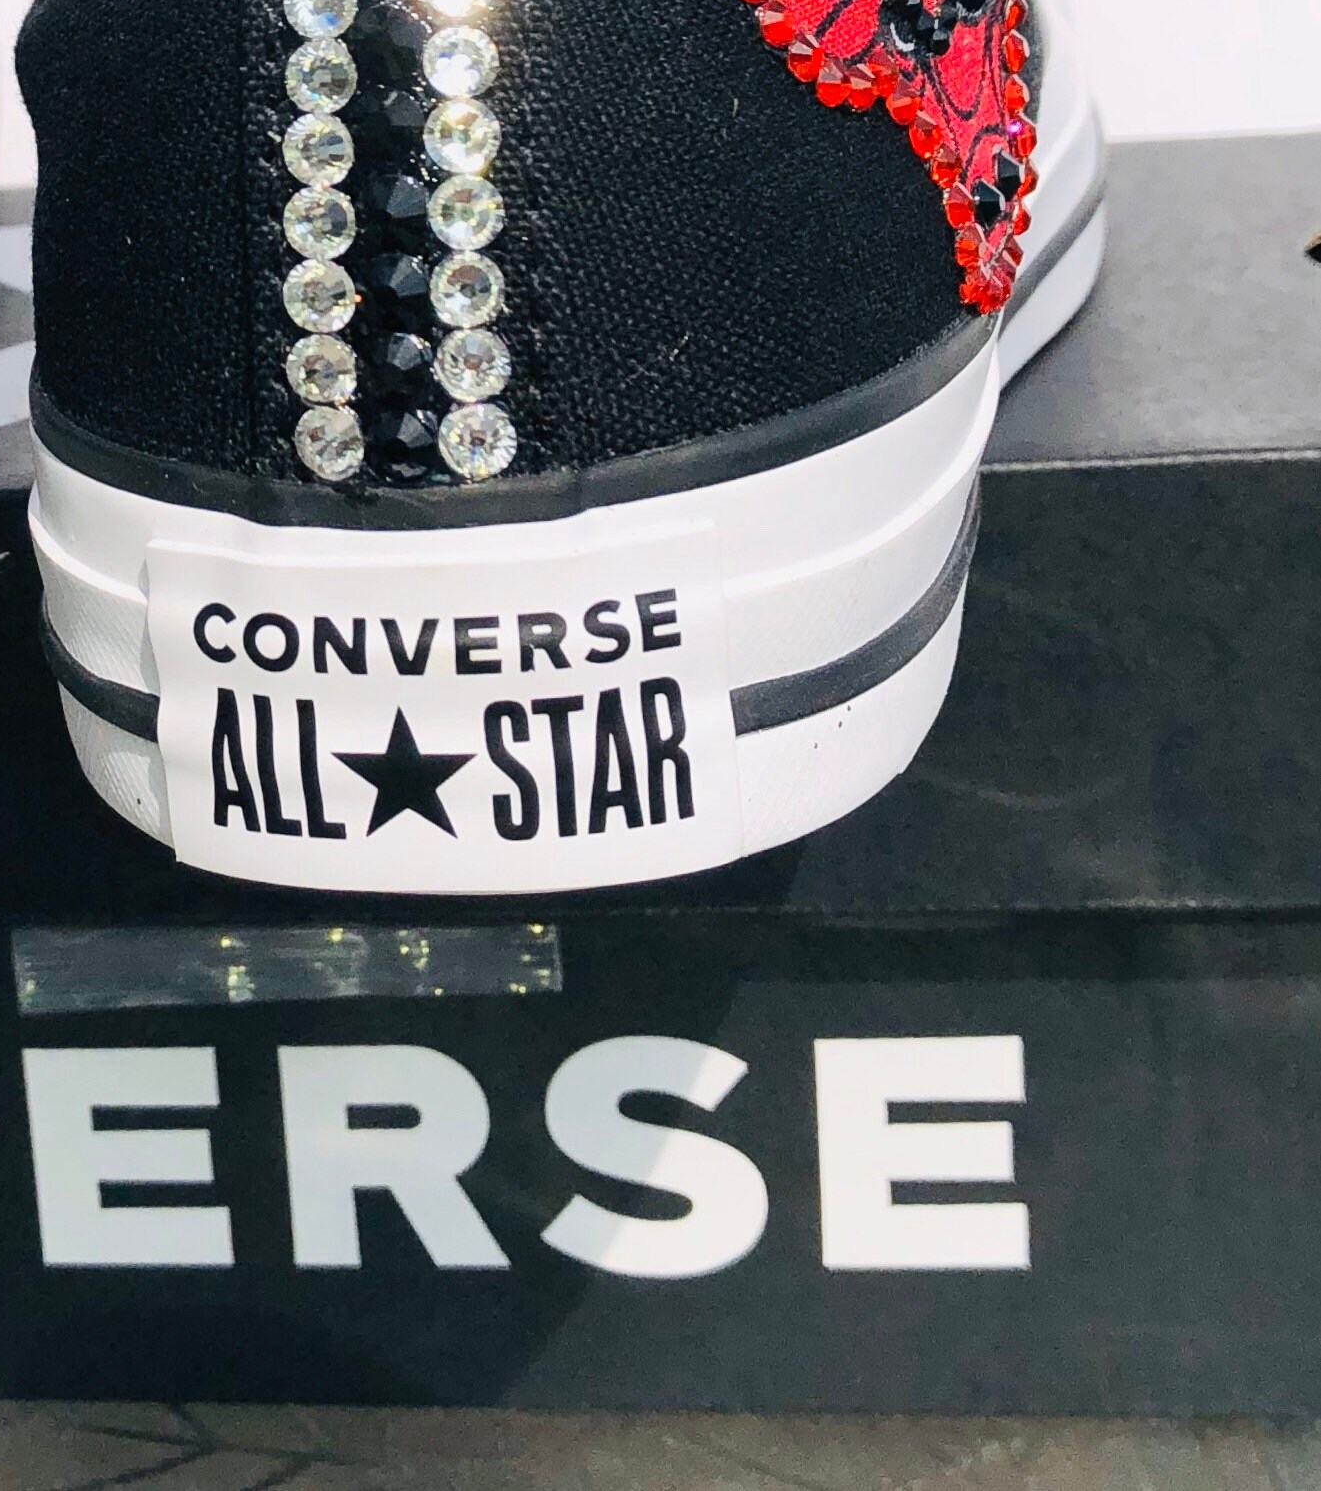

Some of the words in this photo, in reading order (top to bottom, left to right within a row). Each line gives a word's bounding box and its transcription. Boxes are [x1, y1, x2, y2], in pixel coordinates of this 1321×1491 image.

[192, 587, 683, 676] CONVERSE
[211, 687, 347, 841] ALL
[483, 675, 696, 842] STAR
